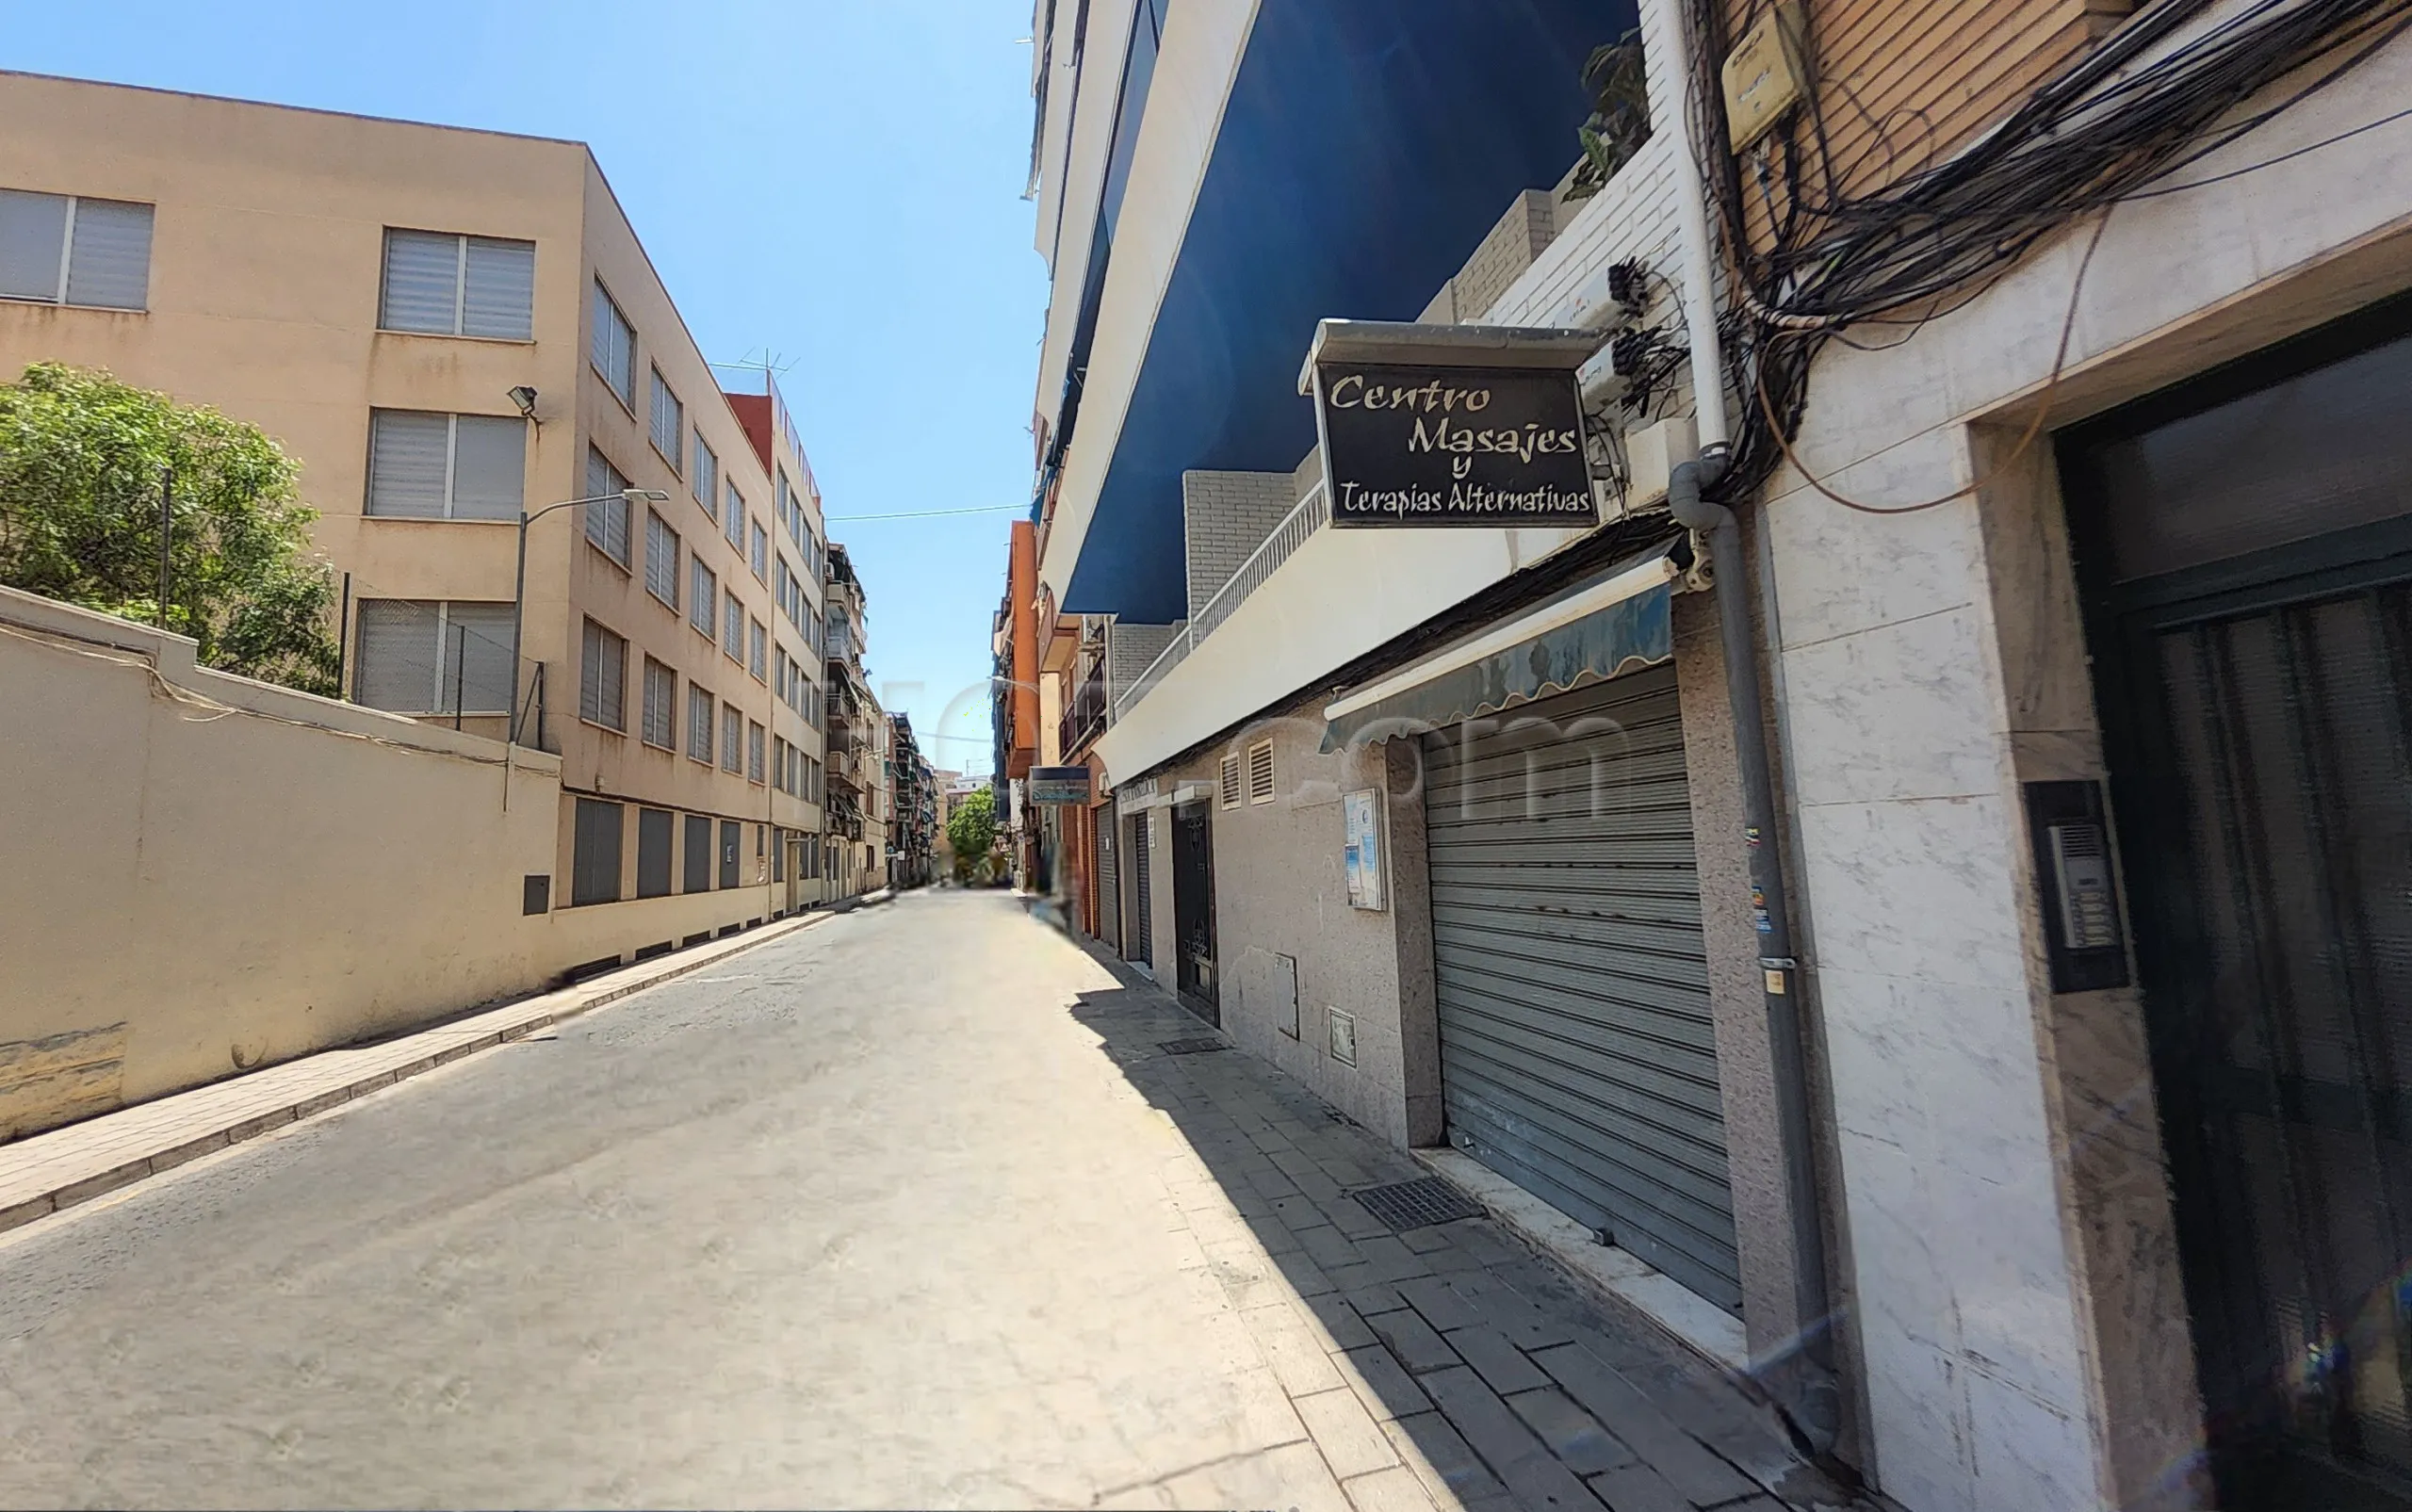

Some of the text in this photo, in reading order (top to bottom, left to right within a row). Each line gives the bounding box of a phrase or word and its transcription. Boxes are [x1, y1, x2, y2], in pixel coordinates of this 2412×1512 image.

[1330, 374, 1491, 413] Centro
[1409, 417, 1577, 463] Masajes
[1452, 455, 1472, 480] y
[1341, 480, 1590, 520] Terapias Alternativas
